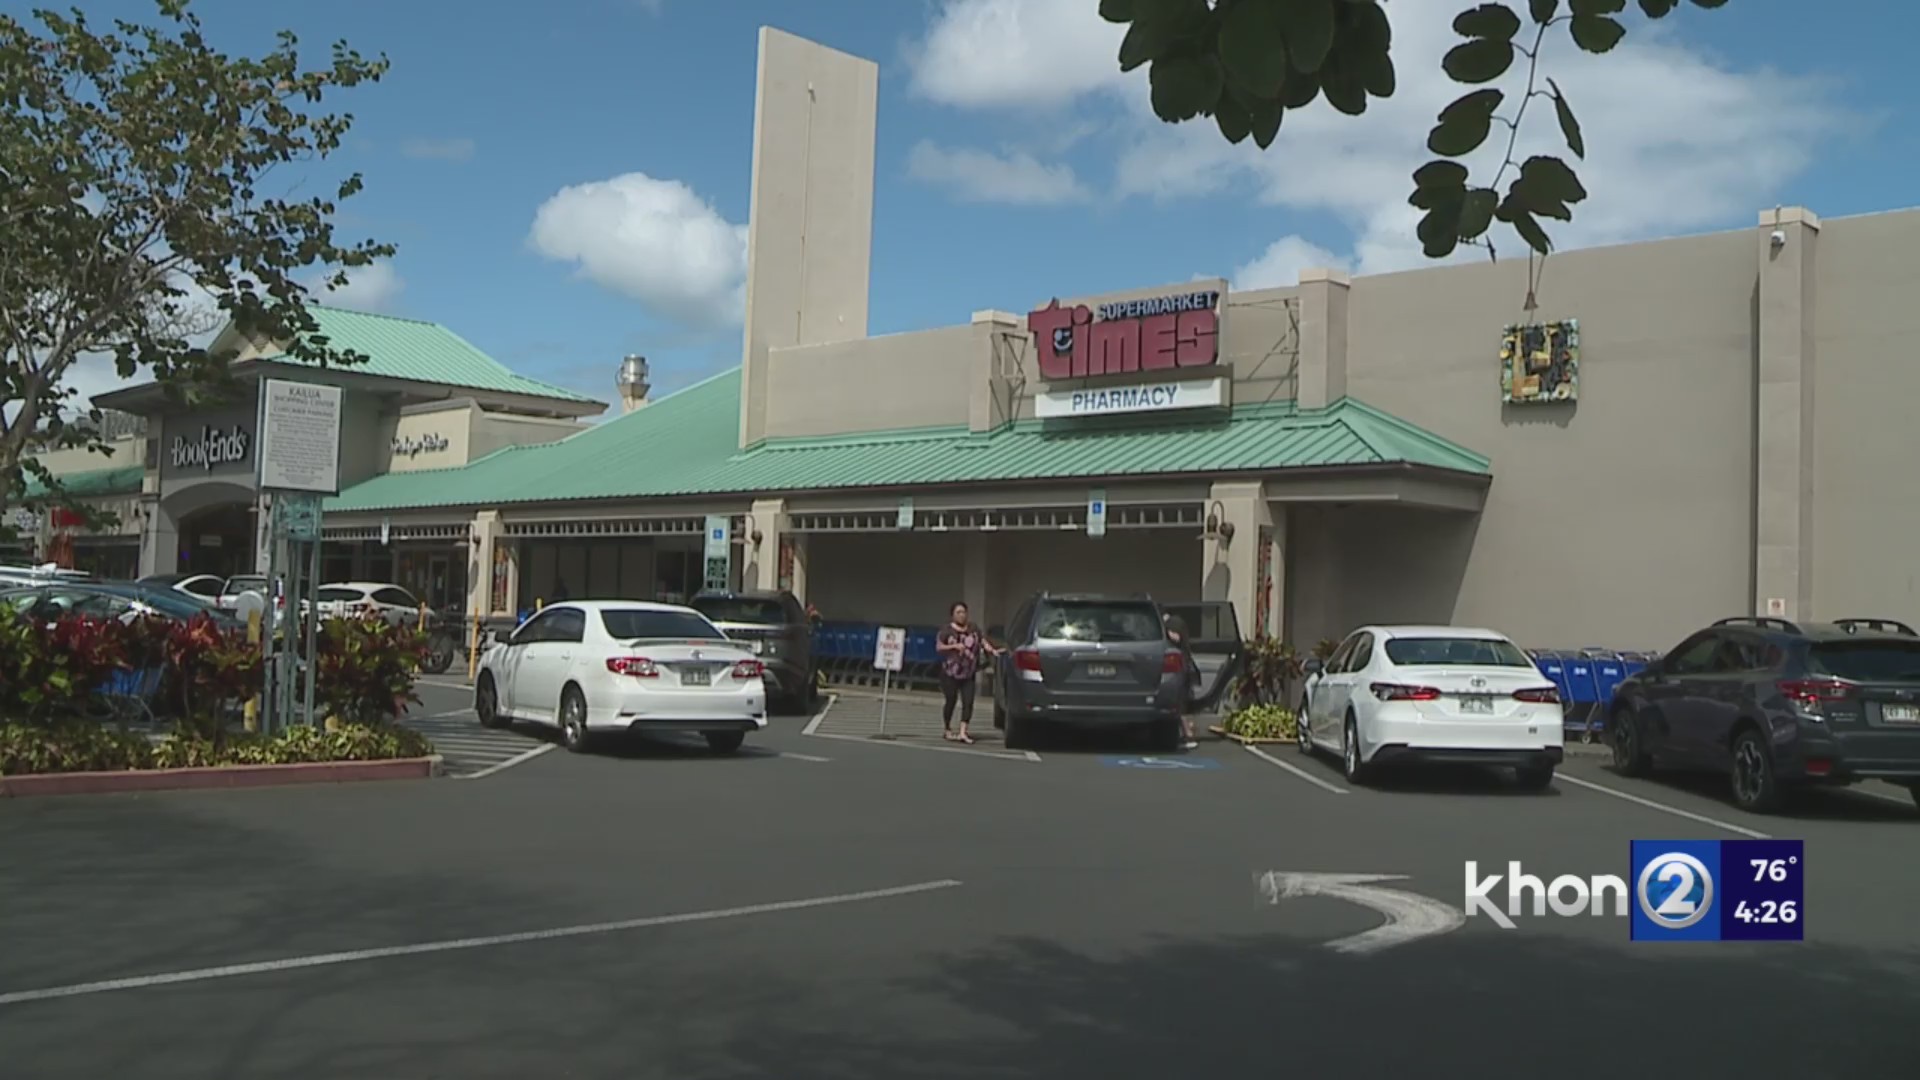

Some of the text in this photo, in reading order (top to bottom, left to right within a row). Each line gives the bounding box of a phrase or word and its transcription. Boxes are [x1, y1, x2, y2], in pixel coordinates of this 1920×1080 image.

[1096, 291, 1218, 321] SUPERMARKET
[289, 387, 321, 399] KAILUA
[1072, 385, 1177, 411] PHARMACY
